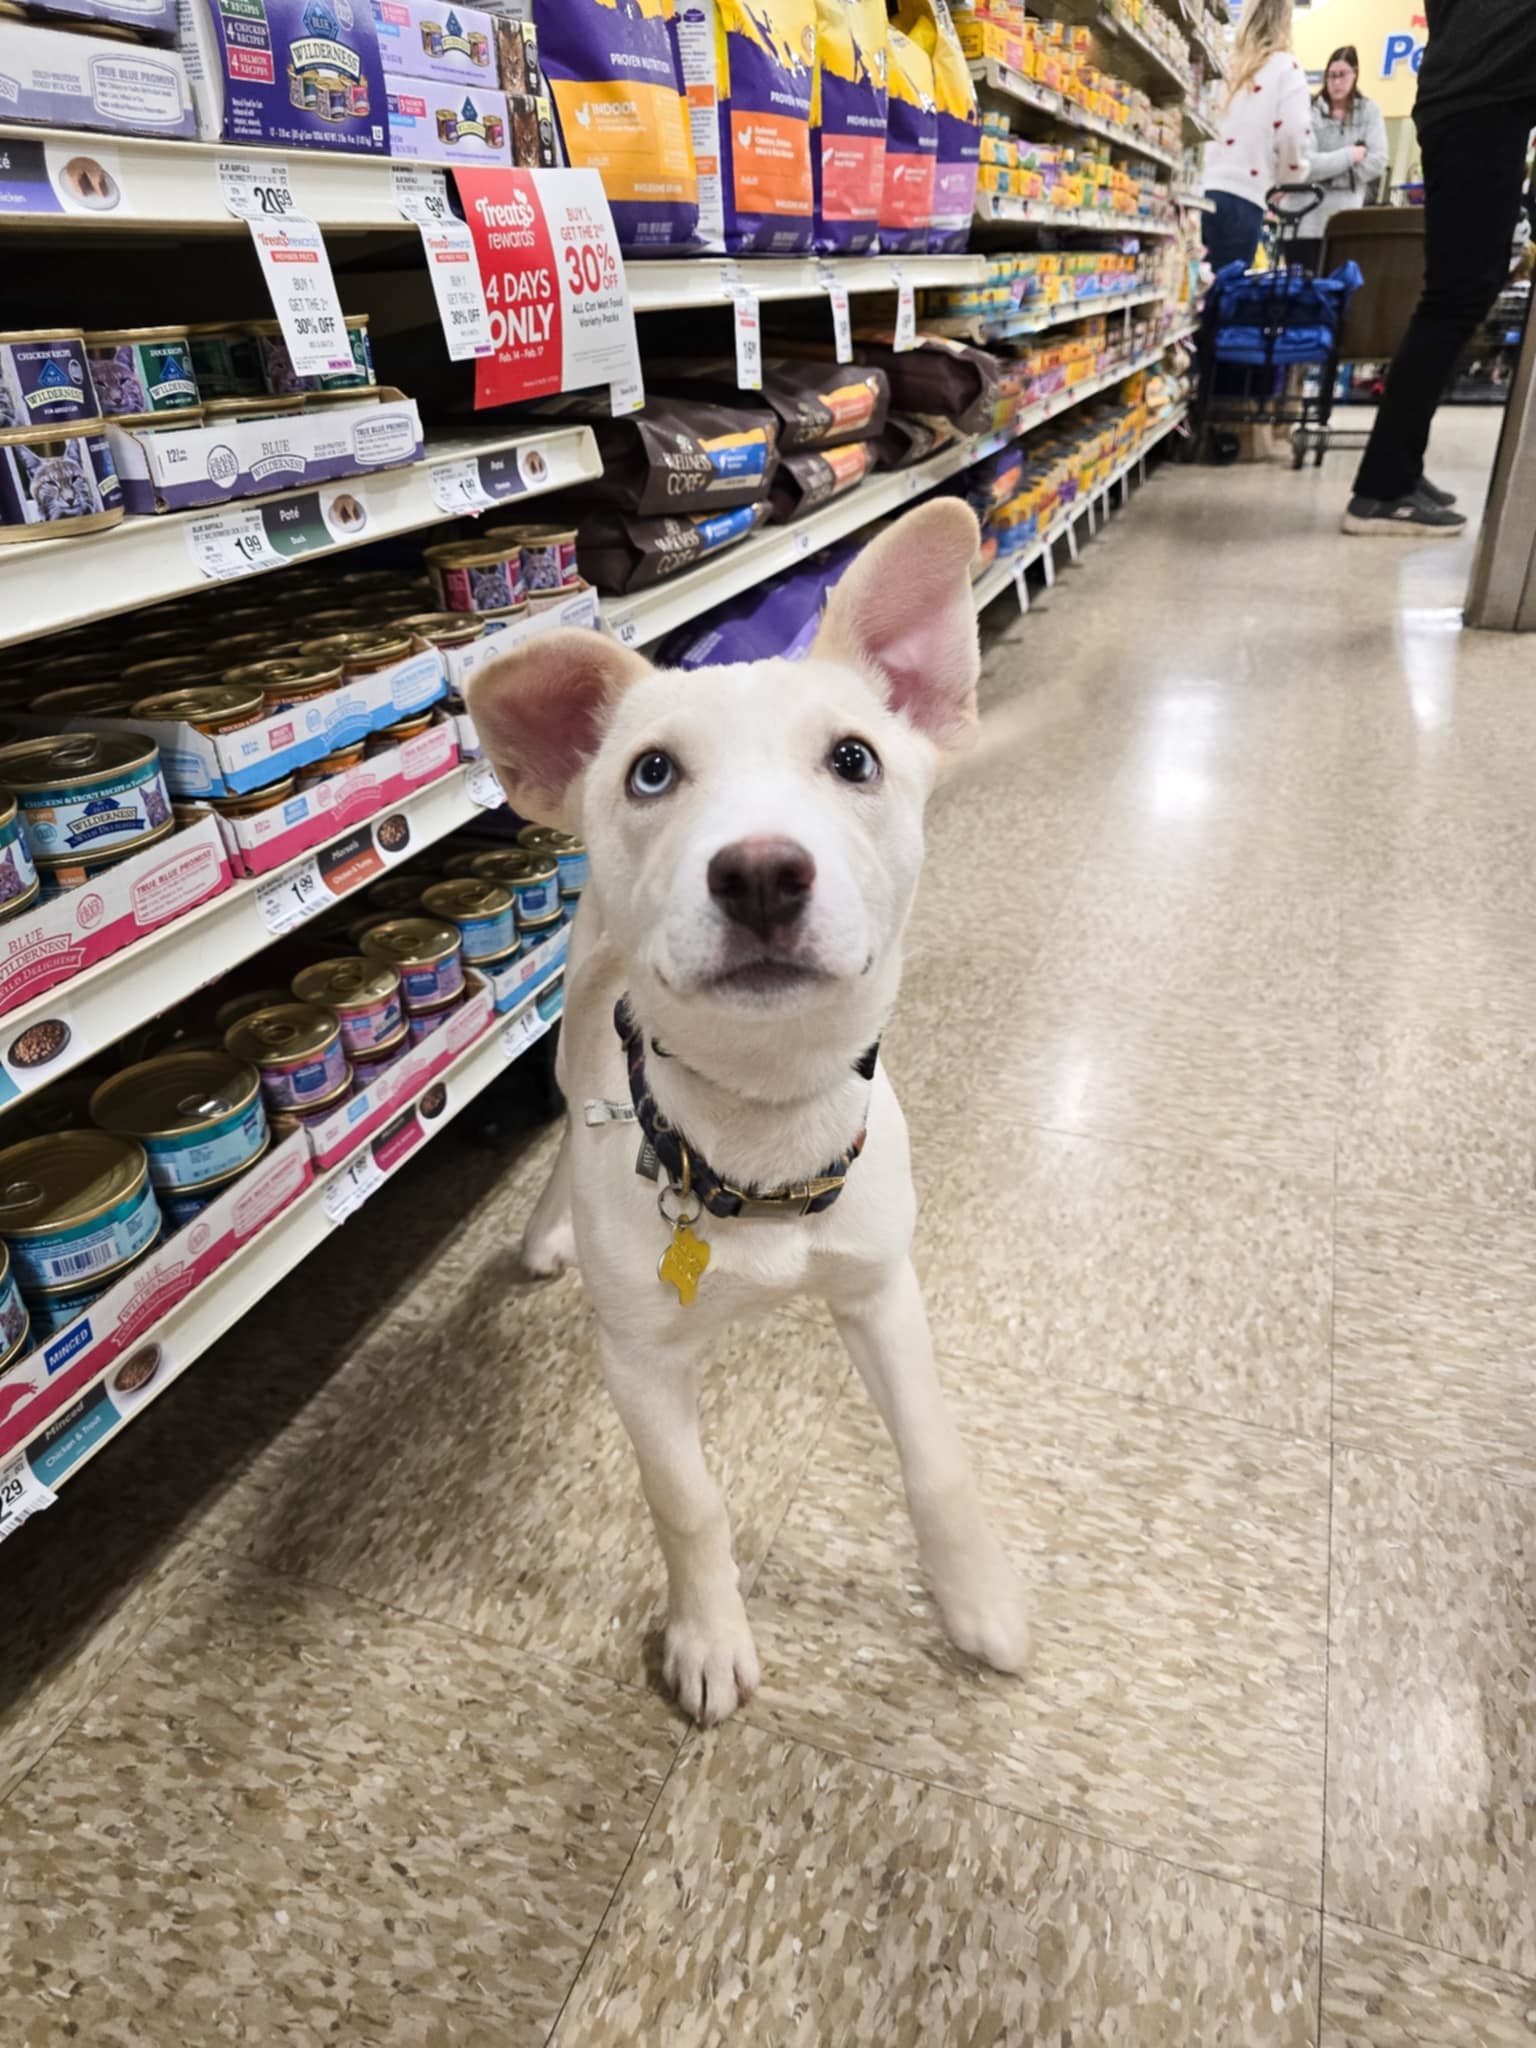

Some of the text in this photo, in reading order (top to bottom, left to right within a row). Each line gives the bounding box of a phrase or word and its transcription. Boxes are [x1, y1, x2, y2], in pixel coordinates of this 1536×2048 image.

[227, 22, 266, 40] 4 CHICKEN
[231, 53, 239, 72] 4
[293, 43, 360, 72] WILDERNESS
[610, 53, 640, 67] PROVEN
[95, 65, 175, 86] TRUE BLUE PROMISE
[591, 103, 637, 115] INDOOR
[475, 196, 535, 228] Treats
[566, 207, 583, 222] BUY
[488, 230, 536, 250] rewards
[560, 226, 577, 241] GET
[577, 225, 593, 240] THE
[565, 243, 616, 296] 30%
[486, 268, 551, 305] 4 DAYS
[603, 273, 618, 291] OFF
[572, 300, 585, 314] ALL
[585, 300, 597, 313] Cat
[609, 296, 623, 309] Food
[294, 317, 335, 335] 30% OFF
[489, 302, 555, 350] ONLY
[579, 311, 620, 329] Variety Packs
[28, 389, 82, 405] WILDERNESS
[152, 381, 196, 397] WILDERNESS
[356, 427, 370, 436] TRUE
[371, 424, 385, 434] BLUE
[261, 439, 290, 456] BLUE
[210, 459, 236, 480] FREE
[253, 459, 303, 479] WILDERNESS
[663, 452, 713, 471] WELLNESS
[70, 792, 99, 803] TROUT
[99, 785, 124, 797] RECIPE
[72, 808, 135, 832] WILDERNESS
[137, 849, 212, 895] TRUE BLUE PROMISE
[8, 927, 45, 955] BLUE
[50, 1328, 90, 1367] MINCED
[45, 1400, 84, 1441] Minced
[46, 1415, 101, 1468] Chicken & Trout
